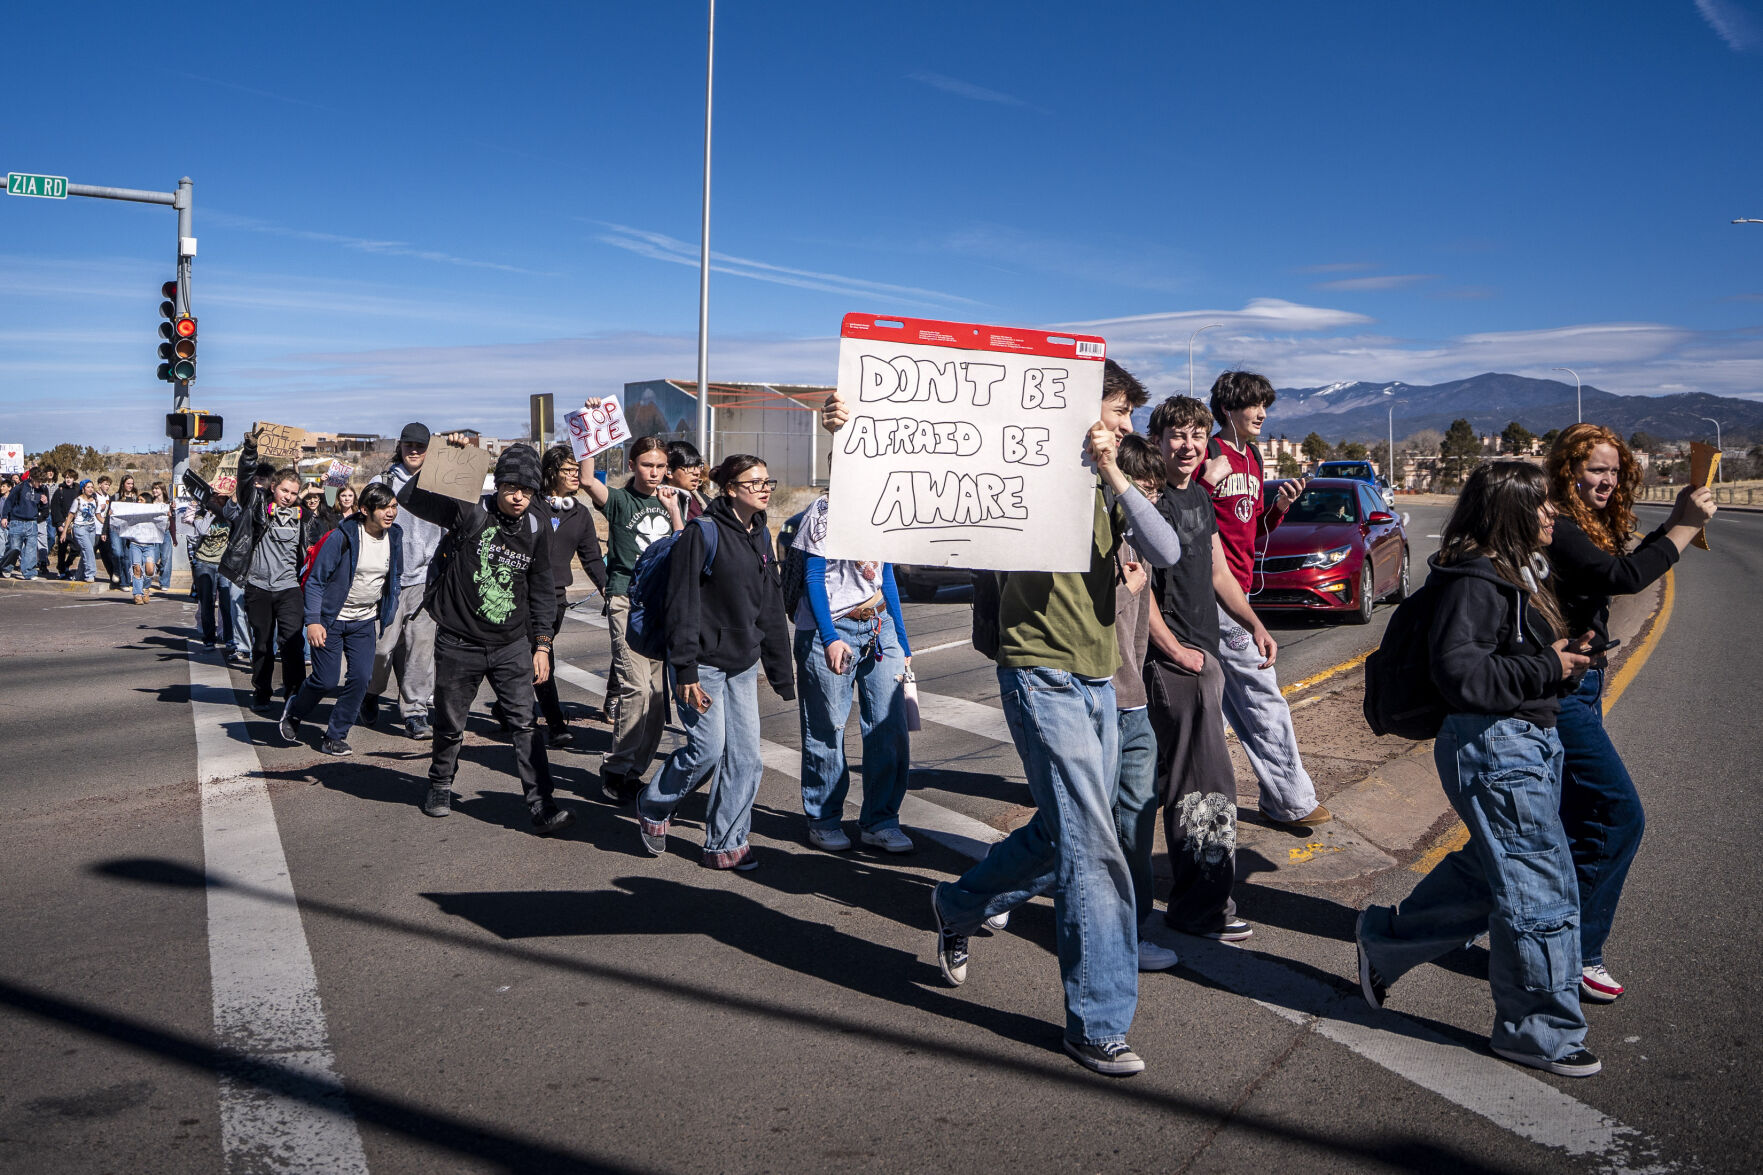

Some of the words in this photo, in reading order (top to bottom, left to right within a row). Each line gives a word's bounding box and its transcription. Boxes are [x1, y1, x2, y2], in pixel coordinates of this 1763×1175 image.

[12, 175, 37, 195] ZIA
[43, 177, 63, 196] RD
[859, 354, 1007, 407] DON'T
[1020, 367, 1069, 410] BE
[259, 421, 294, 439] ICE
[568, 402, 617, 437] STOP
[577, 419, 625, 458] ICE
[843, 415, 983, 459] AFRAID
[1002, 425, 1050, 467] BE
[434, 463, 473, 486] ICE
[437, 447, 478, 471] FUCK
[870, 470, 1029, 527] AWARE
